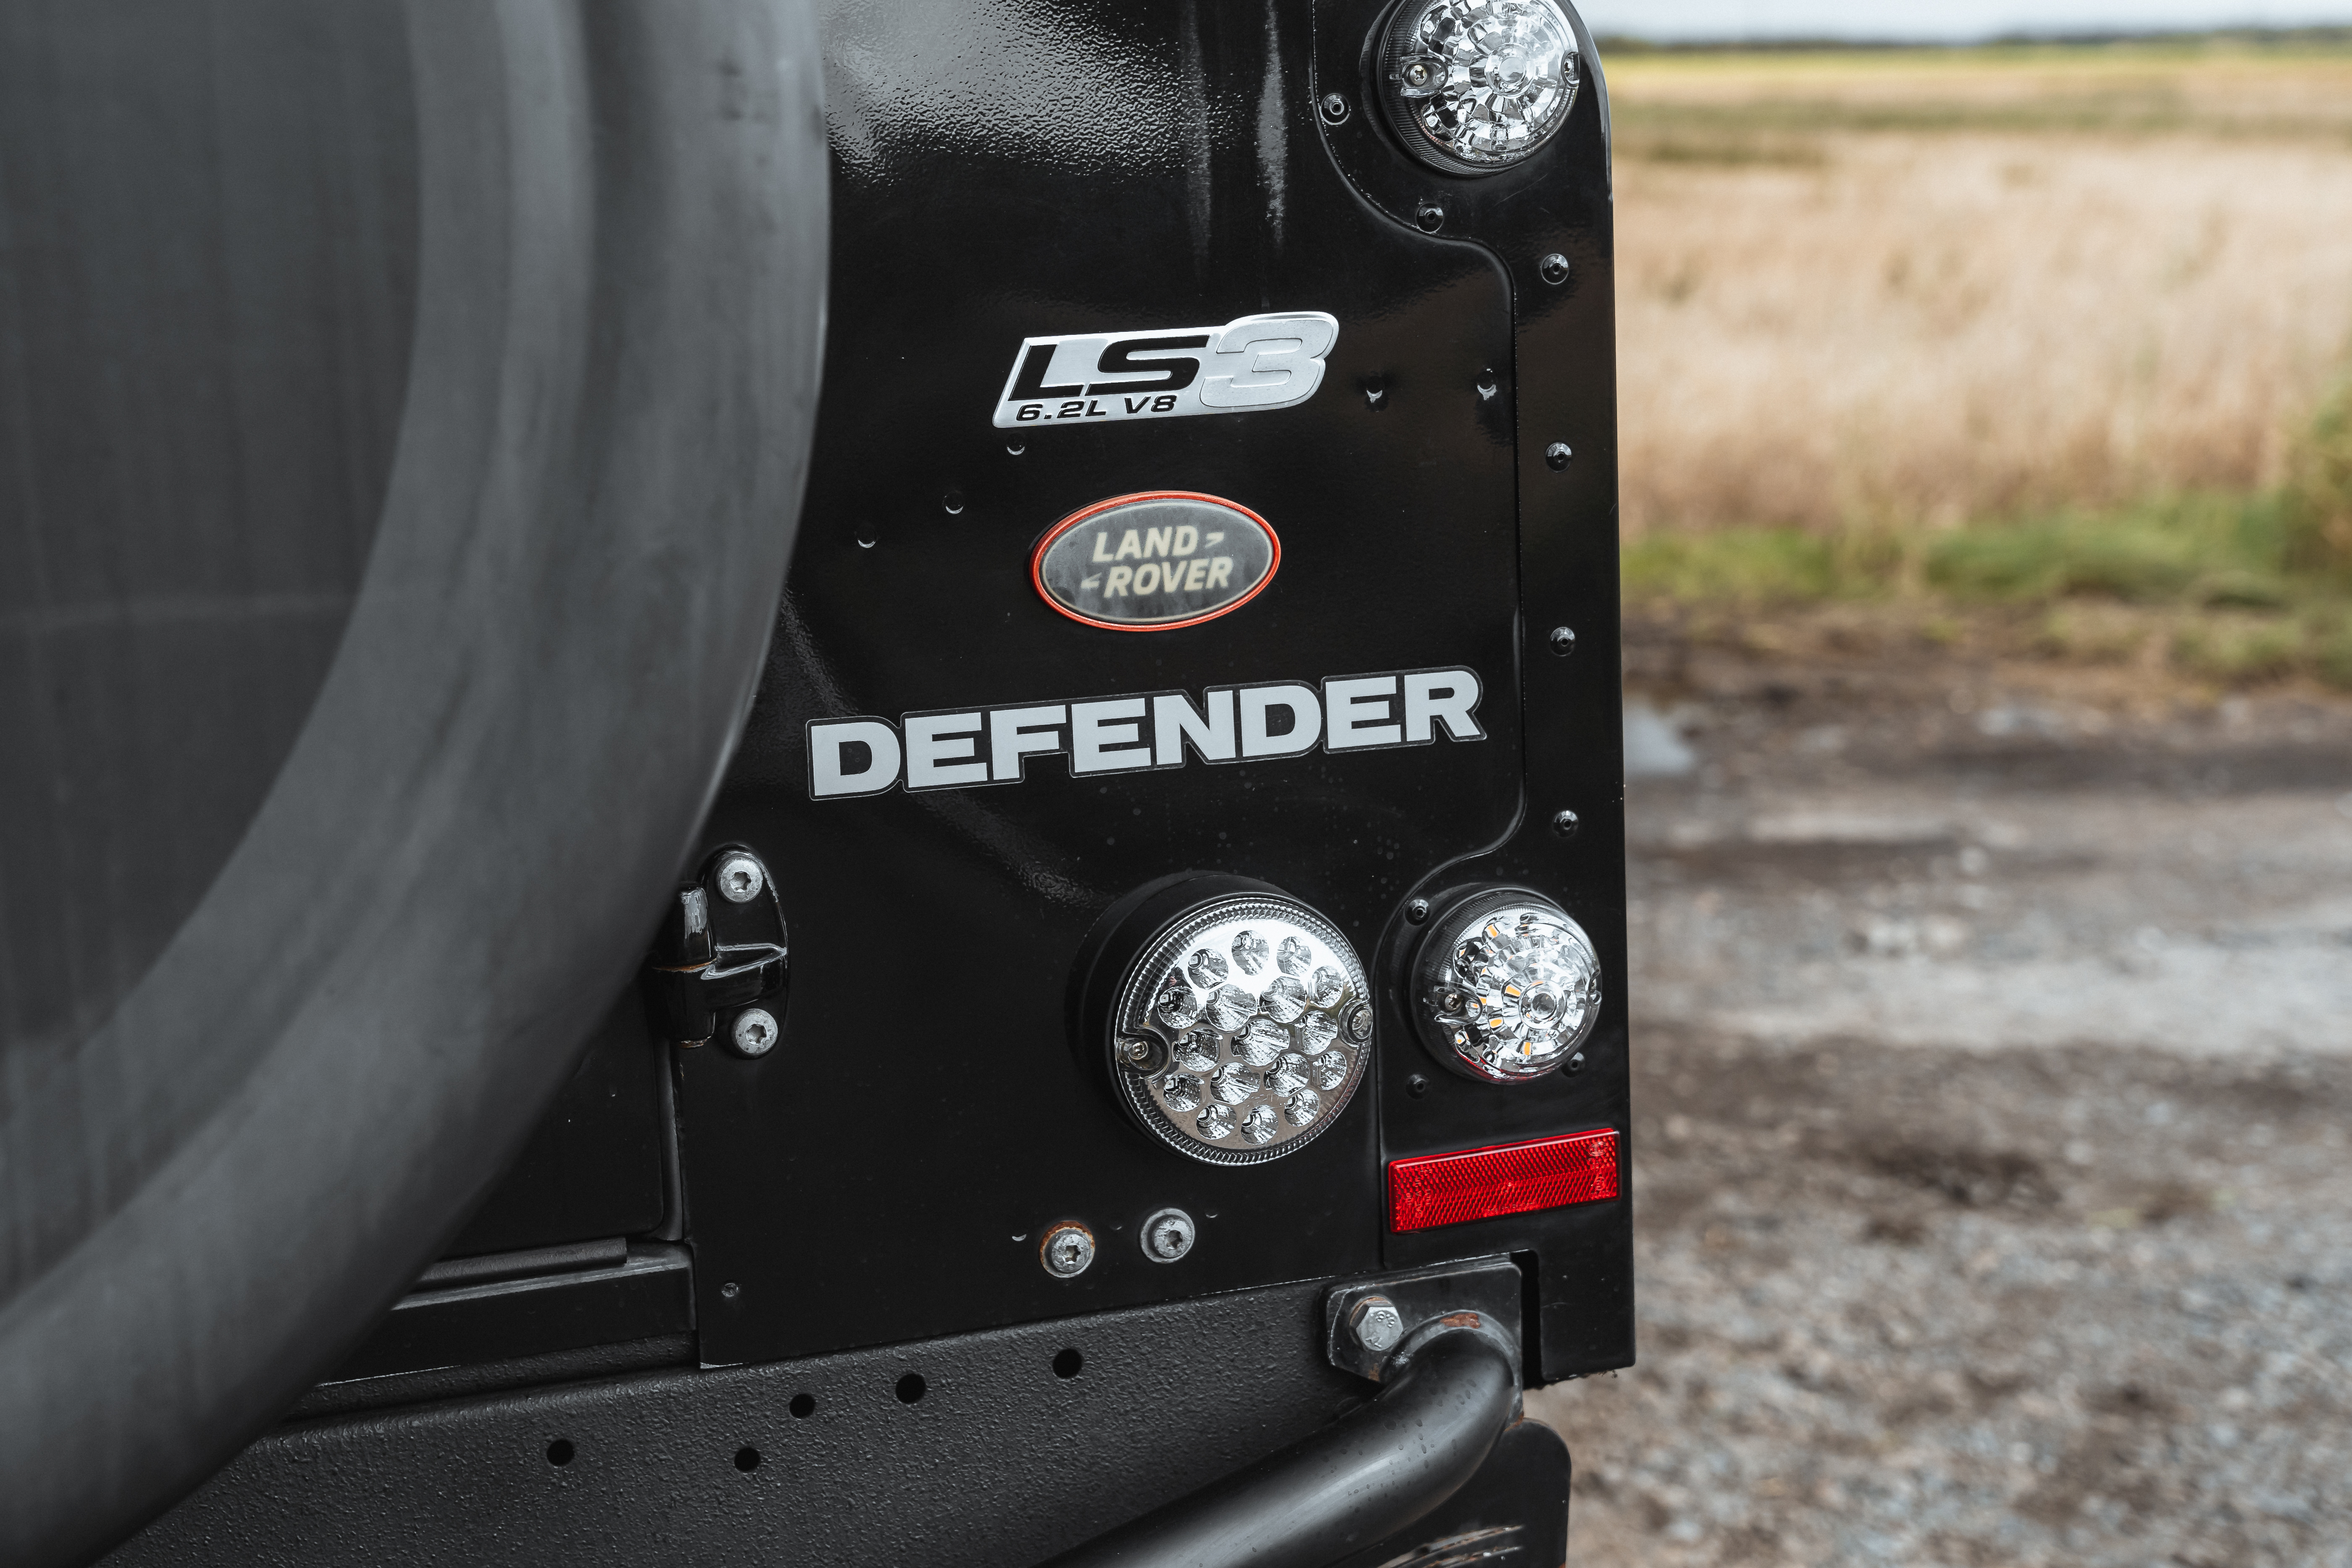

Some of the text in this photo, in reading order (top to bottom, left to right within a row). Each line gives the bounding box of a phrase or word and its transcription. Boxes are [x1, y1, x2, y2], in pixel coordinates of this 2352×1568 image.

[1008, 320, 1334, 407] LS3
[1016, 394, 1177, 421] 6.2L V8
[1093, 525, 1199, 562] LAND
[1103, 556, 1234, 599] ROVER
[811, 670, 1481, 796] DEFENDER
